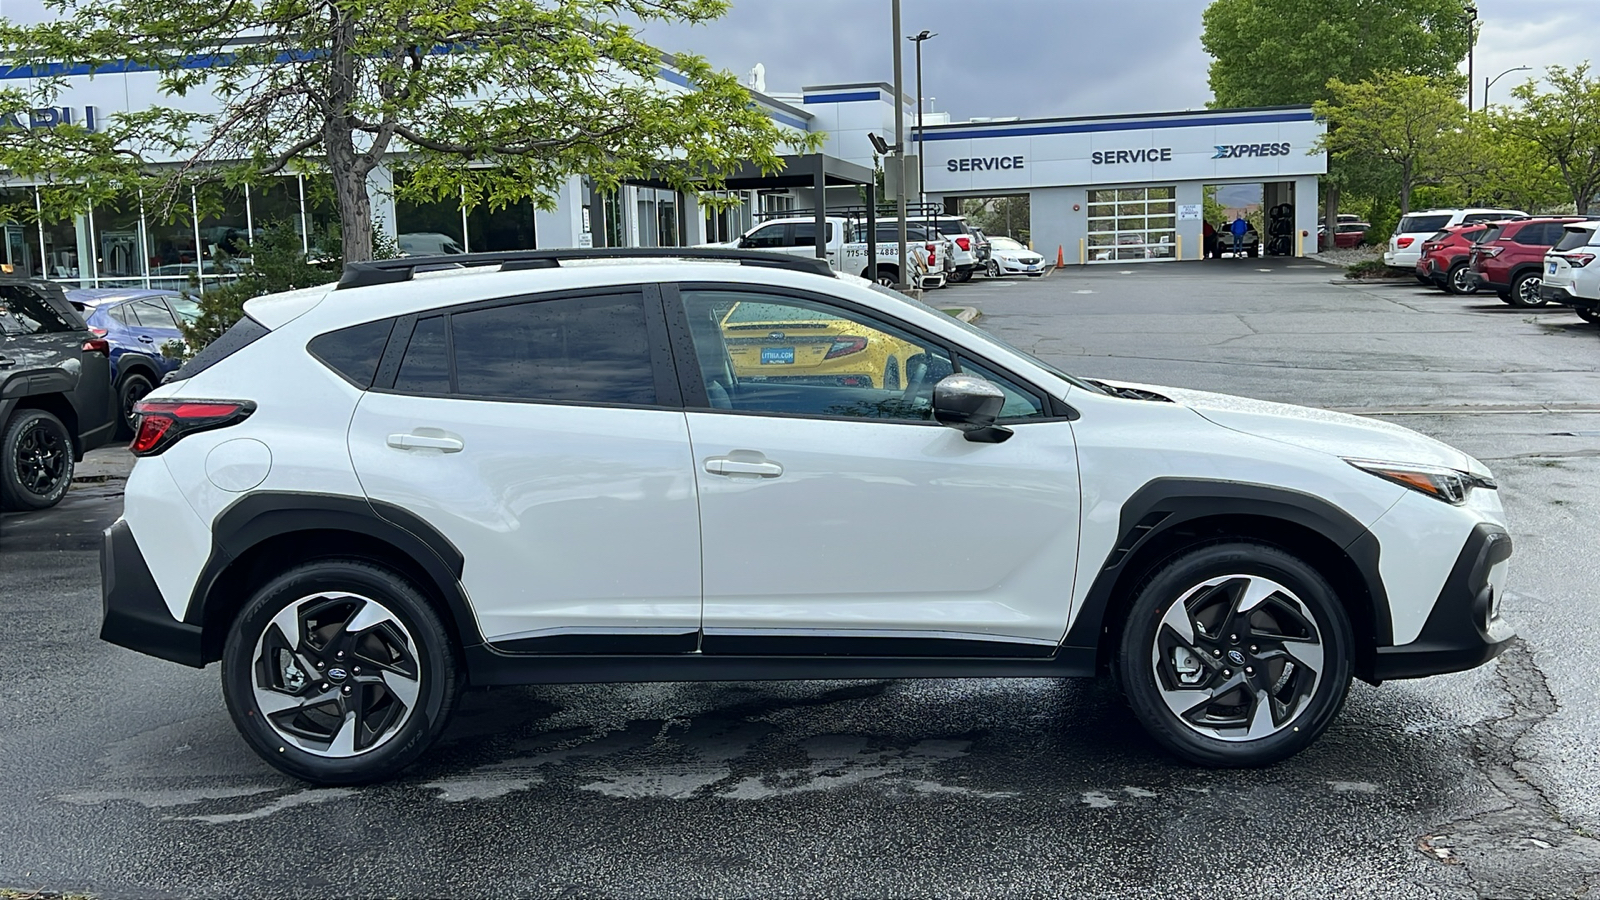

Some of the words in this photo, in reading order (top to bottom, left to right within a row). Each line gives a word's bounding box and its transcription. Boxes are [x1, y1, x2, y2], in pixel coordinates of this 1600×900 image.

[1091, 148, 1172, 165] SERVICE
[1211, 142, 1291, 159] EXPRESS
[947, 156, 1024, 172] SERVICE
[846, 249, 898, 257] 775-8-4883
